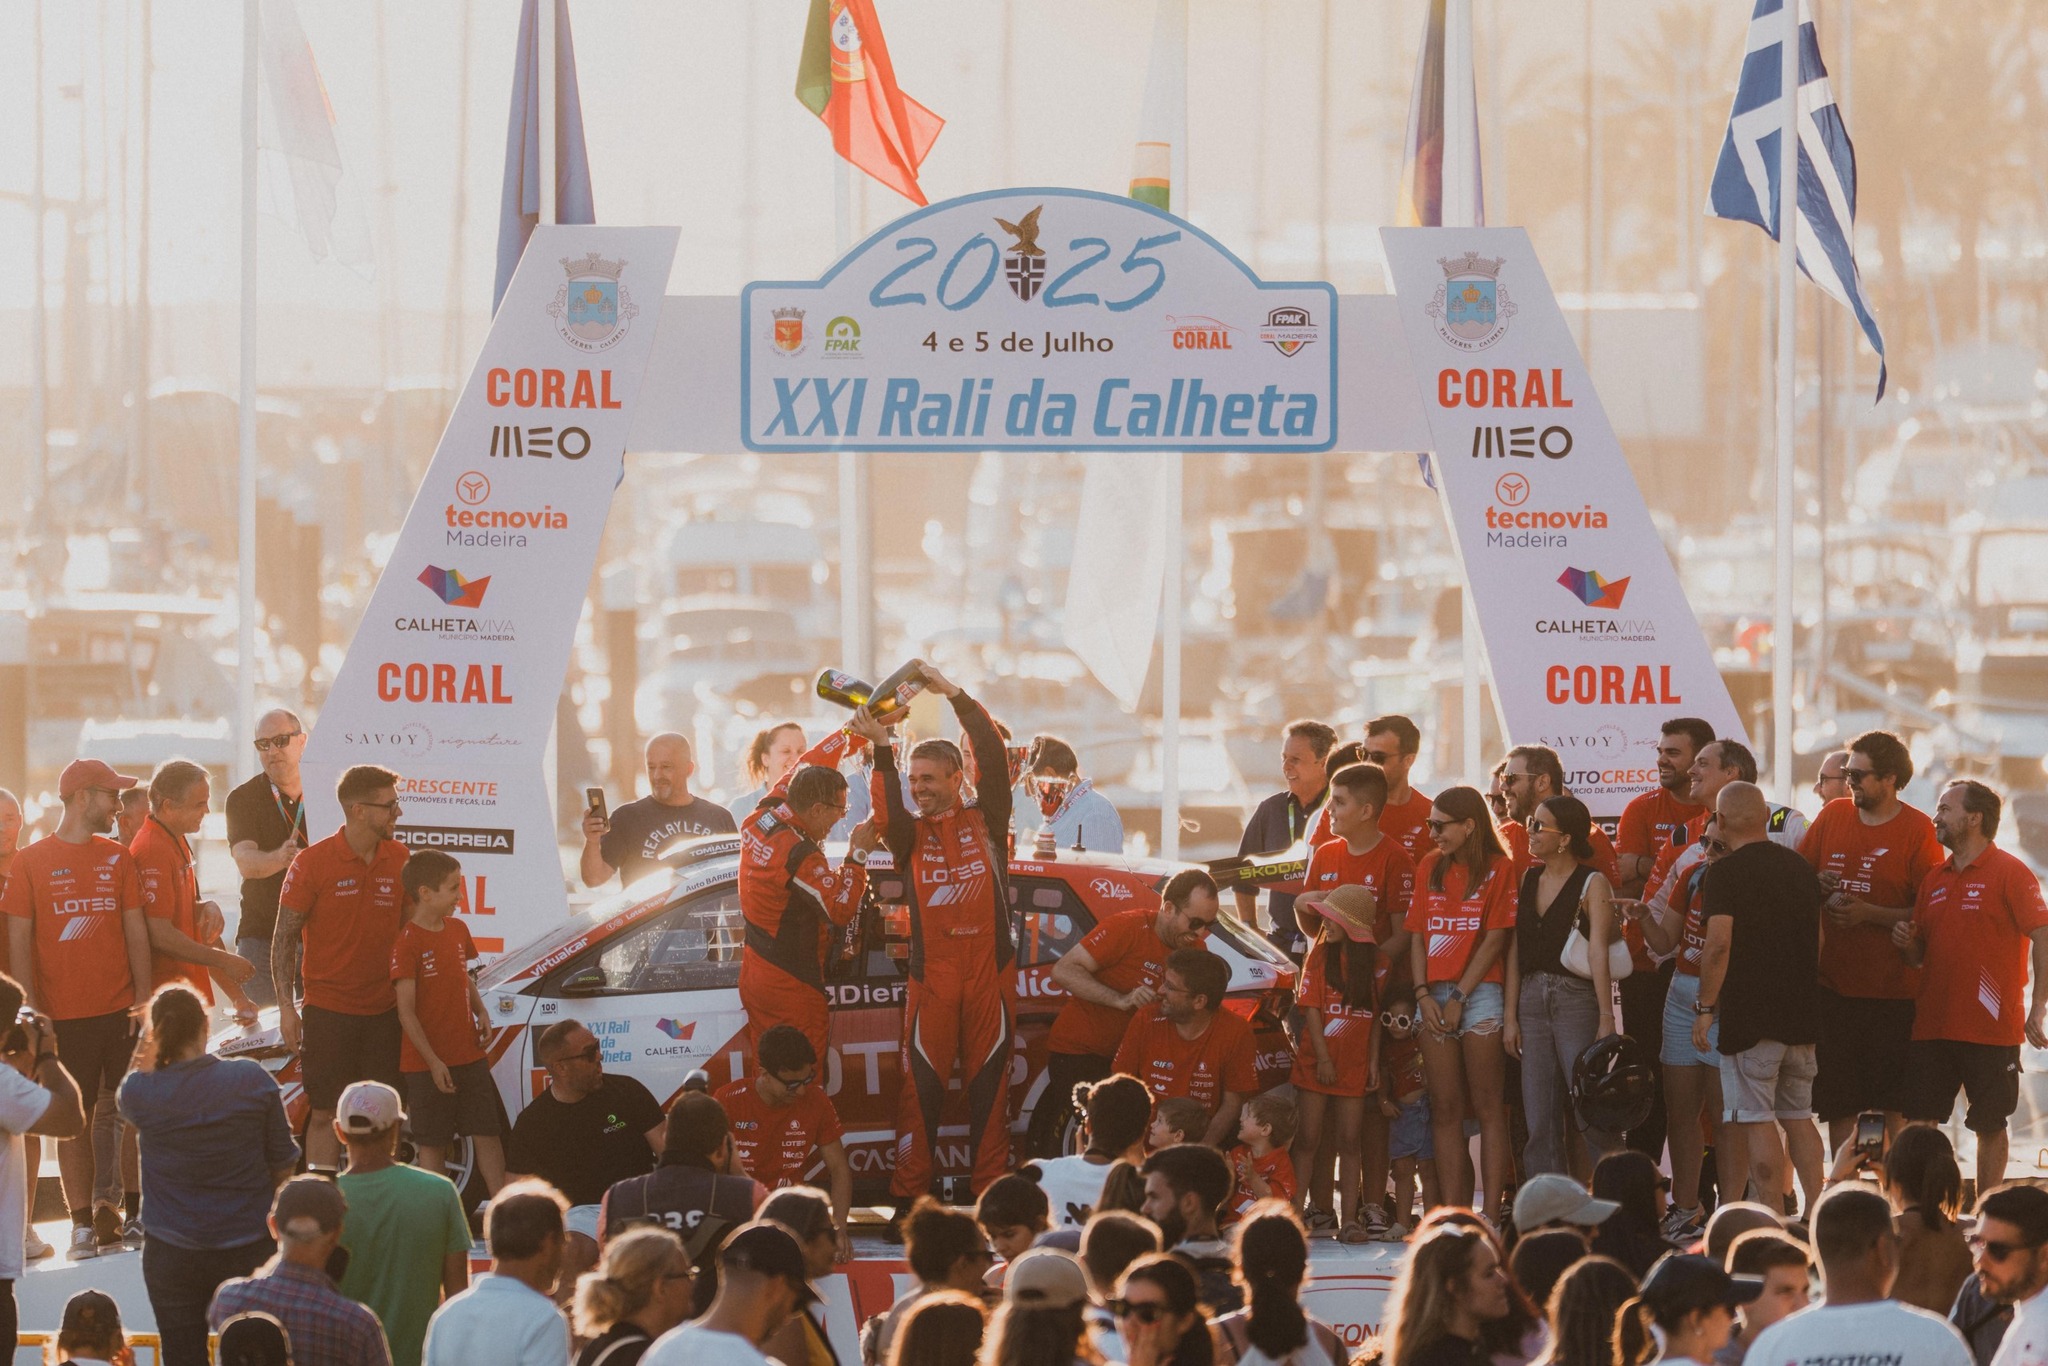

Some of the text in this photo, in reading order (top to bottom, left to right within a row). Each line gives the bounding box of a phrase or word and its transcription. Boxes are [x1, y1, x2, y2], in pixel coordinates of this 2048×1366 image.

[1275, 313, 1303, 325] FPAK
[561, 327, 626, 350] PRAZERES CALHETA
[825, 339, 861, 352] FPAK
[922, 331, 1115, 359] 4 e 5 de Julho
[1173, 331, 1233, 350] CORAL
[1440, 325, 1505, 350] PRAZERES CALHETA
[486, 367, 622, 410] CORAL
[1438, 368, 1574, 408] CORAL
[762, 376, 1319, 438] XXI Rali da Calheta
[490, 425, 591, 460] MEO
[1472, 425, 1573, 460] MEO
[445, 504, 568, 529] tecnovia
[1485, 504, 1608, 529] tecnovia
[446, 530, 527, 548] Madeira
[1486, 531, 1567, 548] Madeira
[480, 634, 516, 642] MADEIRA
[377, 662, 513, 704] CORAL
[1546, 665, 1682, 705] CORAL
[345, 733, 522, 749] SAVOY signature
[1539, 736, 1614, 747] SAVOY
[455, 798, 481, 806] PEÇAS,
[1655, 823, 1669, 831] elf
[750, 852, 768, 868] TEAM
[685, 881, 706, 893] Auto
[52, 897, 117, 915] LOTES
[1427, 916, 1481, 931] LOTES
[530, 936, 589, 978] virtualcar
[1143, 961, 1157, 971] elf
[541, 1002, 556, 1012] 100
[586, 1020, 630, 1035] XXI Rali
[601, 1036, 616, 1049] da
[1151, 1072, 1173, 1082] virtualcar
